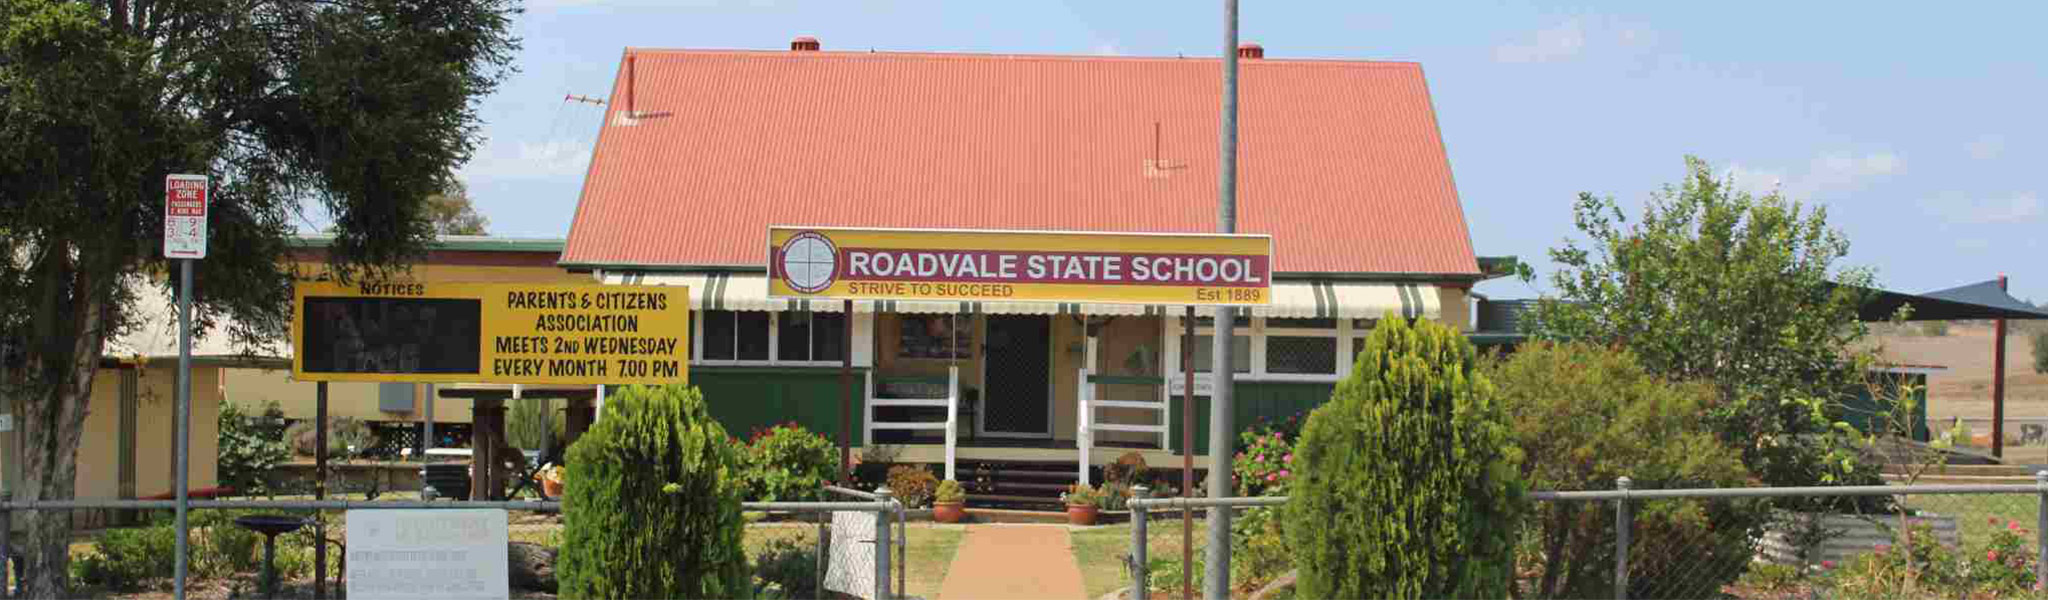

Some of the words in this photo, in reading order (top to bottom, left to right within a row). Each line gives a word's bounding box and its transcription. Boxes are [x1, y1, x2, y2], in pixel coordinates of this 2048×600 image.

[170, 180, 204, 190] LOADING
[176, 190, 199, 199] ZONE
[849, 251, 1018, 278] ROADVALE
[1027, 254, 1122, 280] STATE
[1131, 256, 1262, 283] SCHOOL
[361, 283, 424, 296] NOTICES
[848, 281, 905, 295] STRIVE
[911, 283, 932, 296] TO
[936, 283, 1014, 297] SUCCEED
[1197, 287, 1221, 301] Est
[1227, 288, 1261, 301] 1889
[508, 291, 576, 308] PARENTS
[580, 292, 592, 308] &
[596, 292, 667, 310] CITIZENS
[535, 314, 638, 332] ASSOCIATION
[495, 336, 548, 354] MEETS
[584, 337, 677, 355] WEDNESDAY
[494, 358, 544, 376] EVERY
[548, 359, 606, 377] MONTH
[653, 360, 678, 377] PM
